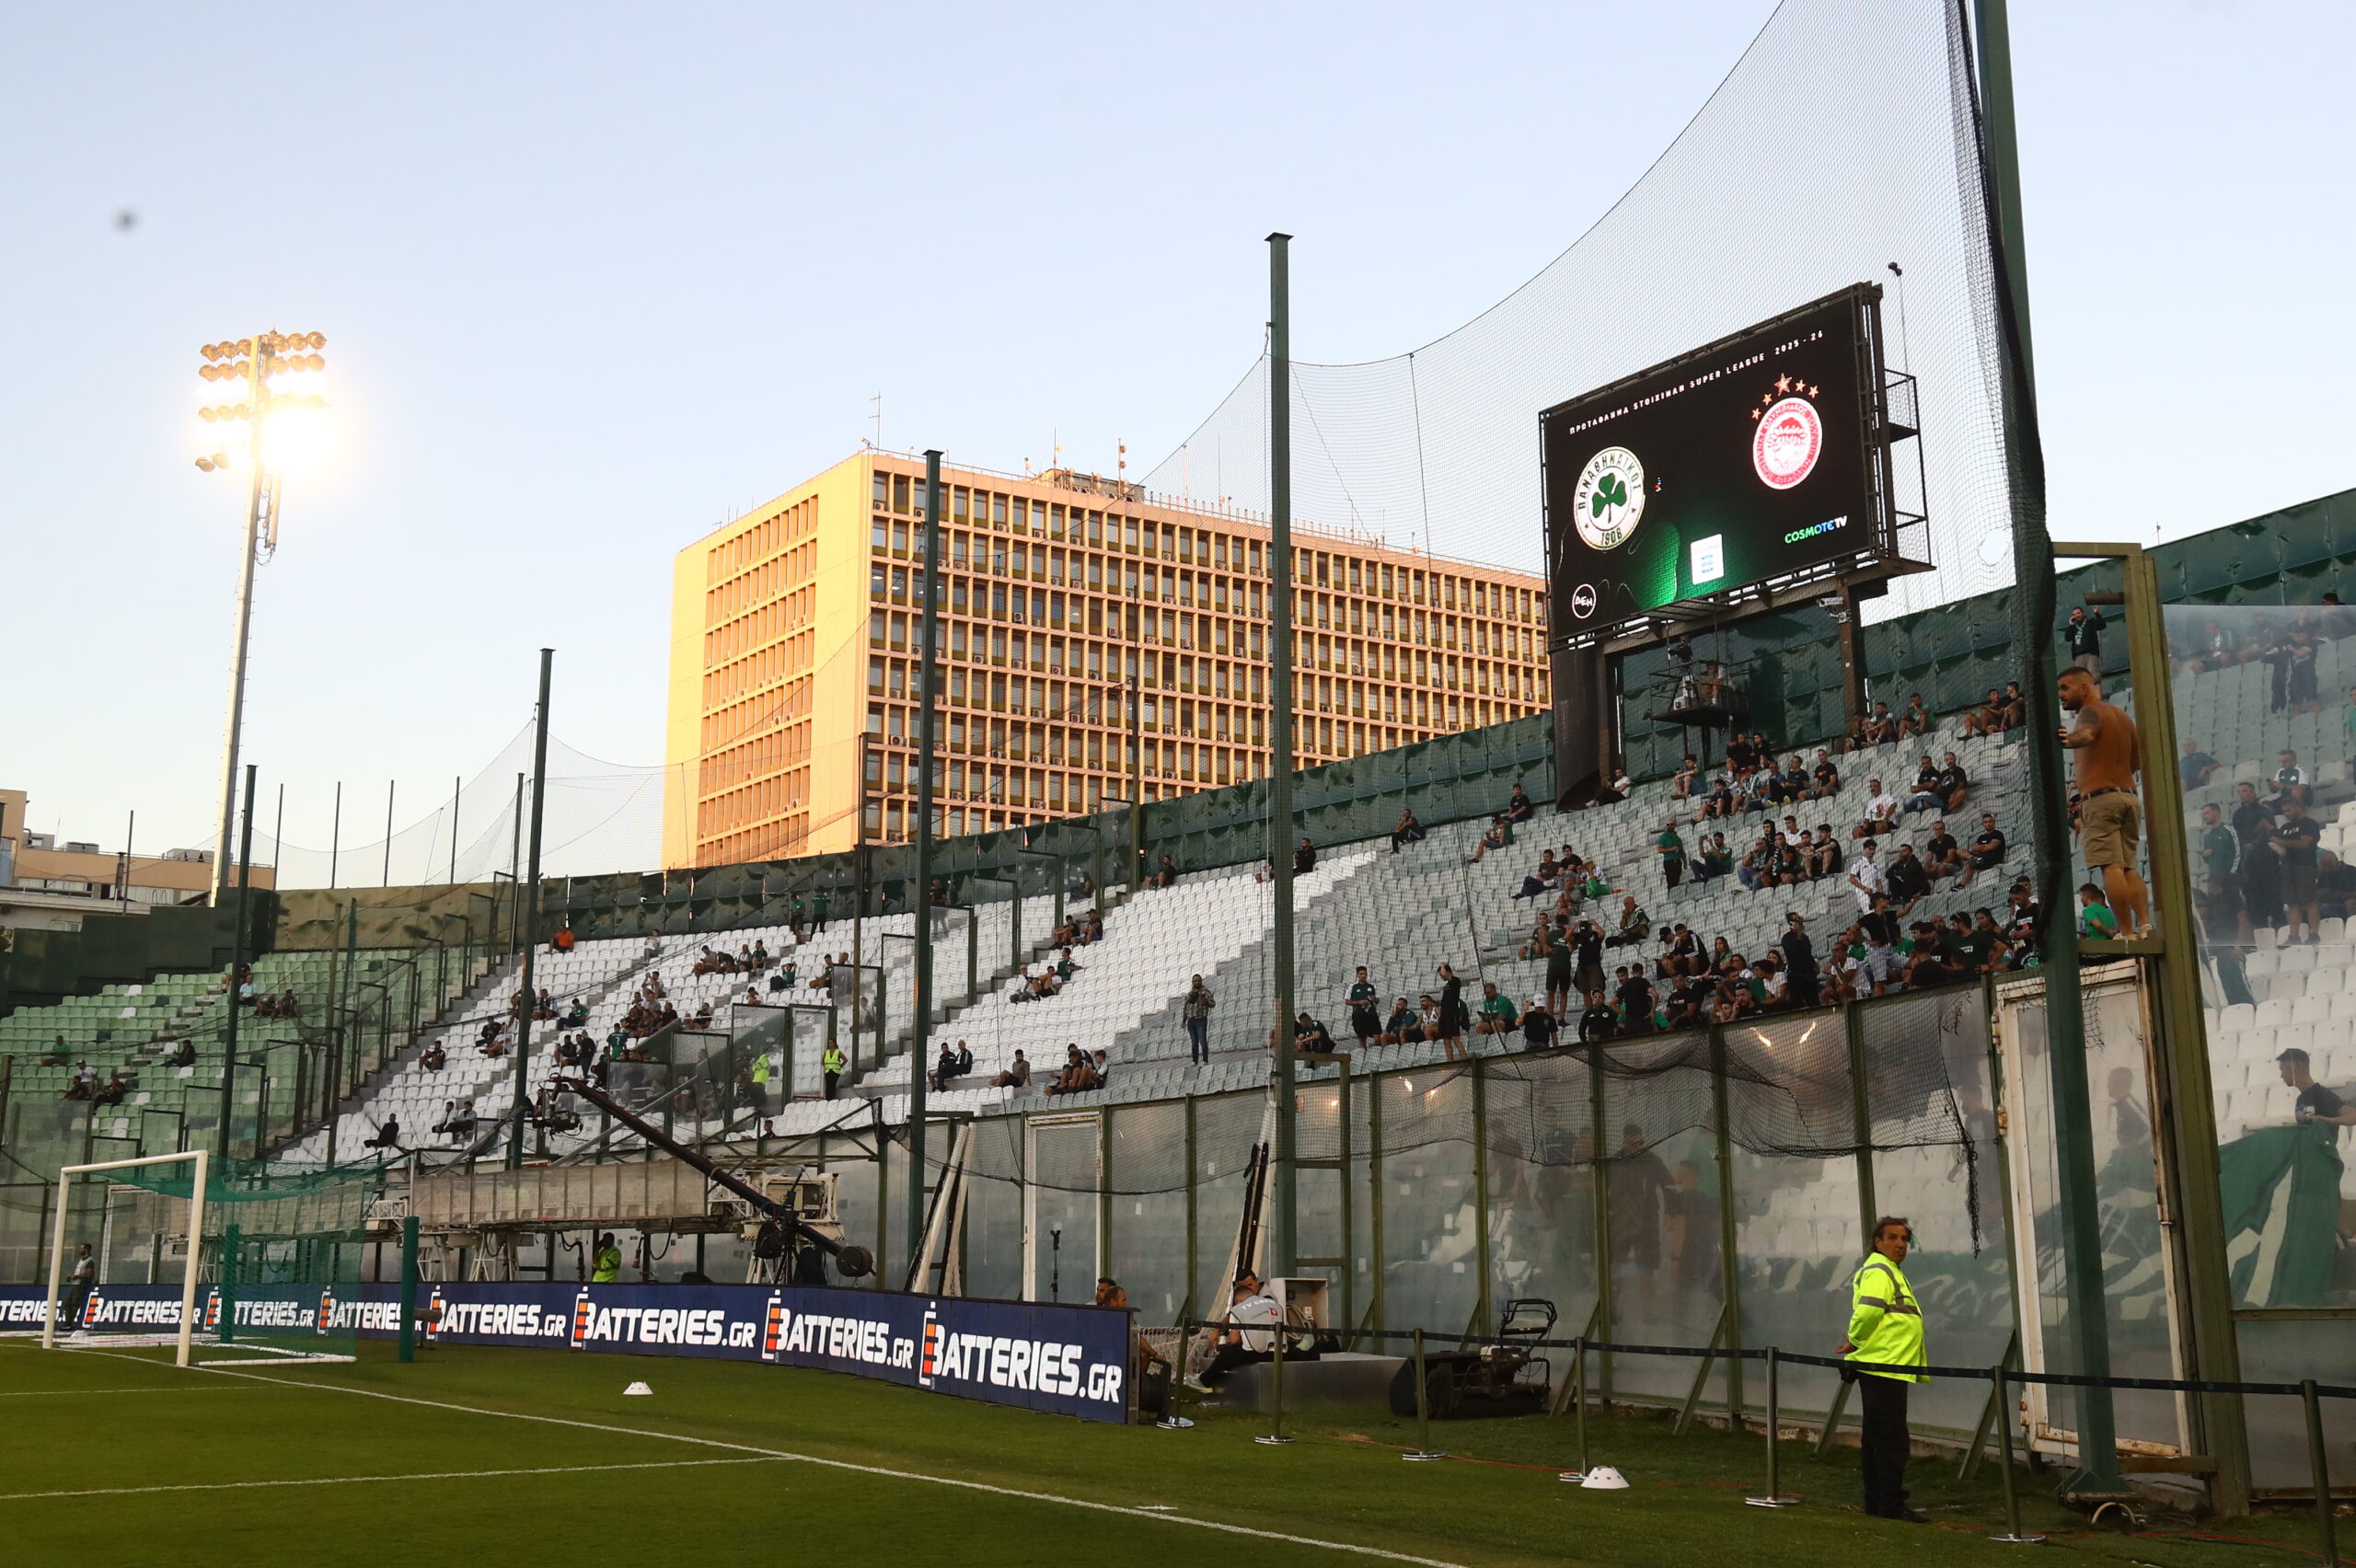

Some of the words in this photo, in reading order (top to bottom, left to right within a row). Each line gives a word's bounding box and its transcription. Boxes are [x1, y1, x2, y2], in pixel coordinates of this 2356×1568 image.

[1633, 384, 1685, 410] STOIXIMAN
[1690, 370, 1721, 388] SUPER
[1726, 352, 1765, 375] LEAGUE
[1600, 527, 1623, 546] 1908
[1575, 595, 1593, 607] ΔΕΗ
[83, 1297, 201, 1325] BATTERIES.R
[206, 1297, 314, 1328] BTTERIES.GR
[573, 1301, 757, 1348] BATTERIES.GR
[766, 1307, 915, 1371] BATTERIES.GR
[922, 1322, 1123, 1404] BATTERIES.GR
